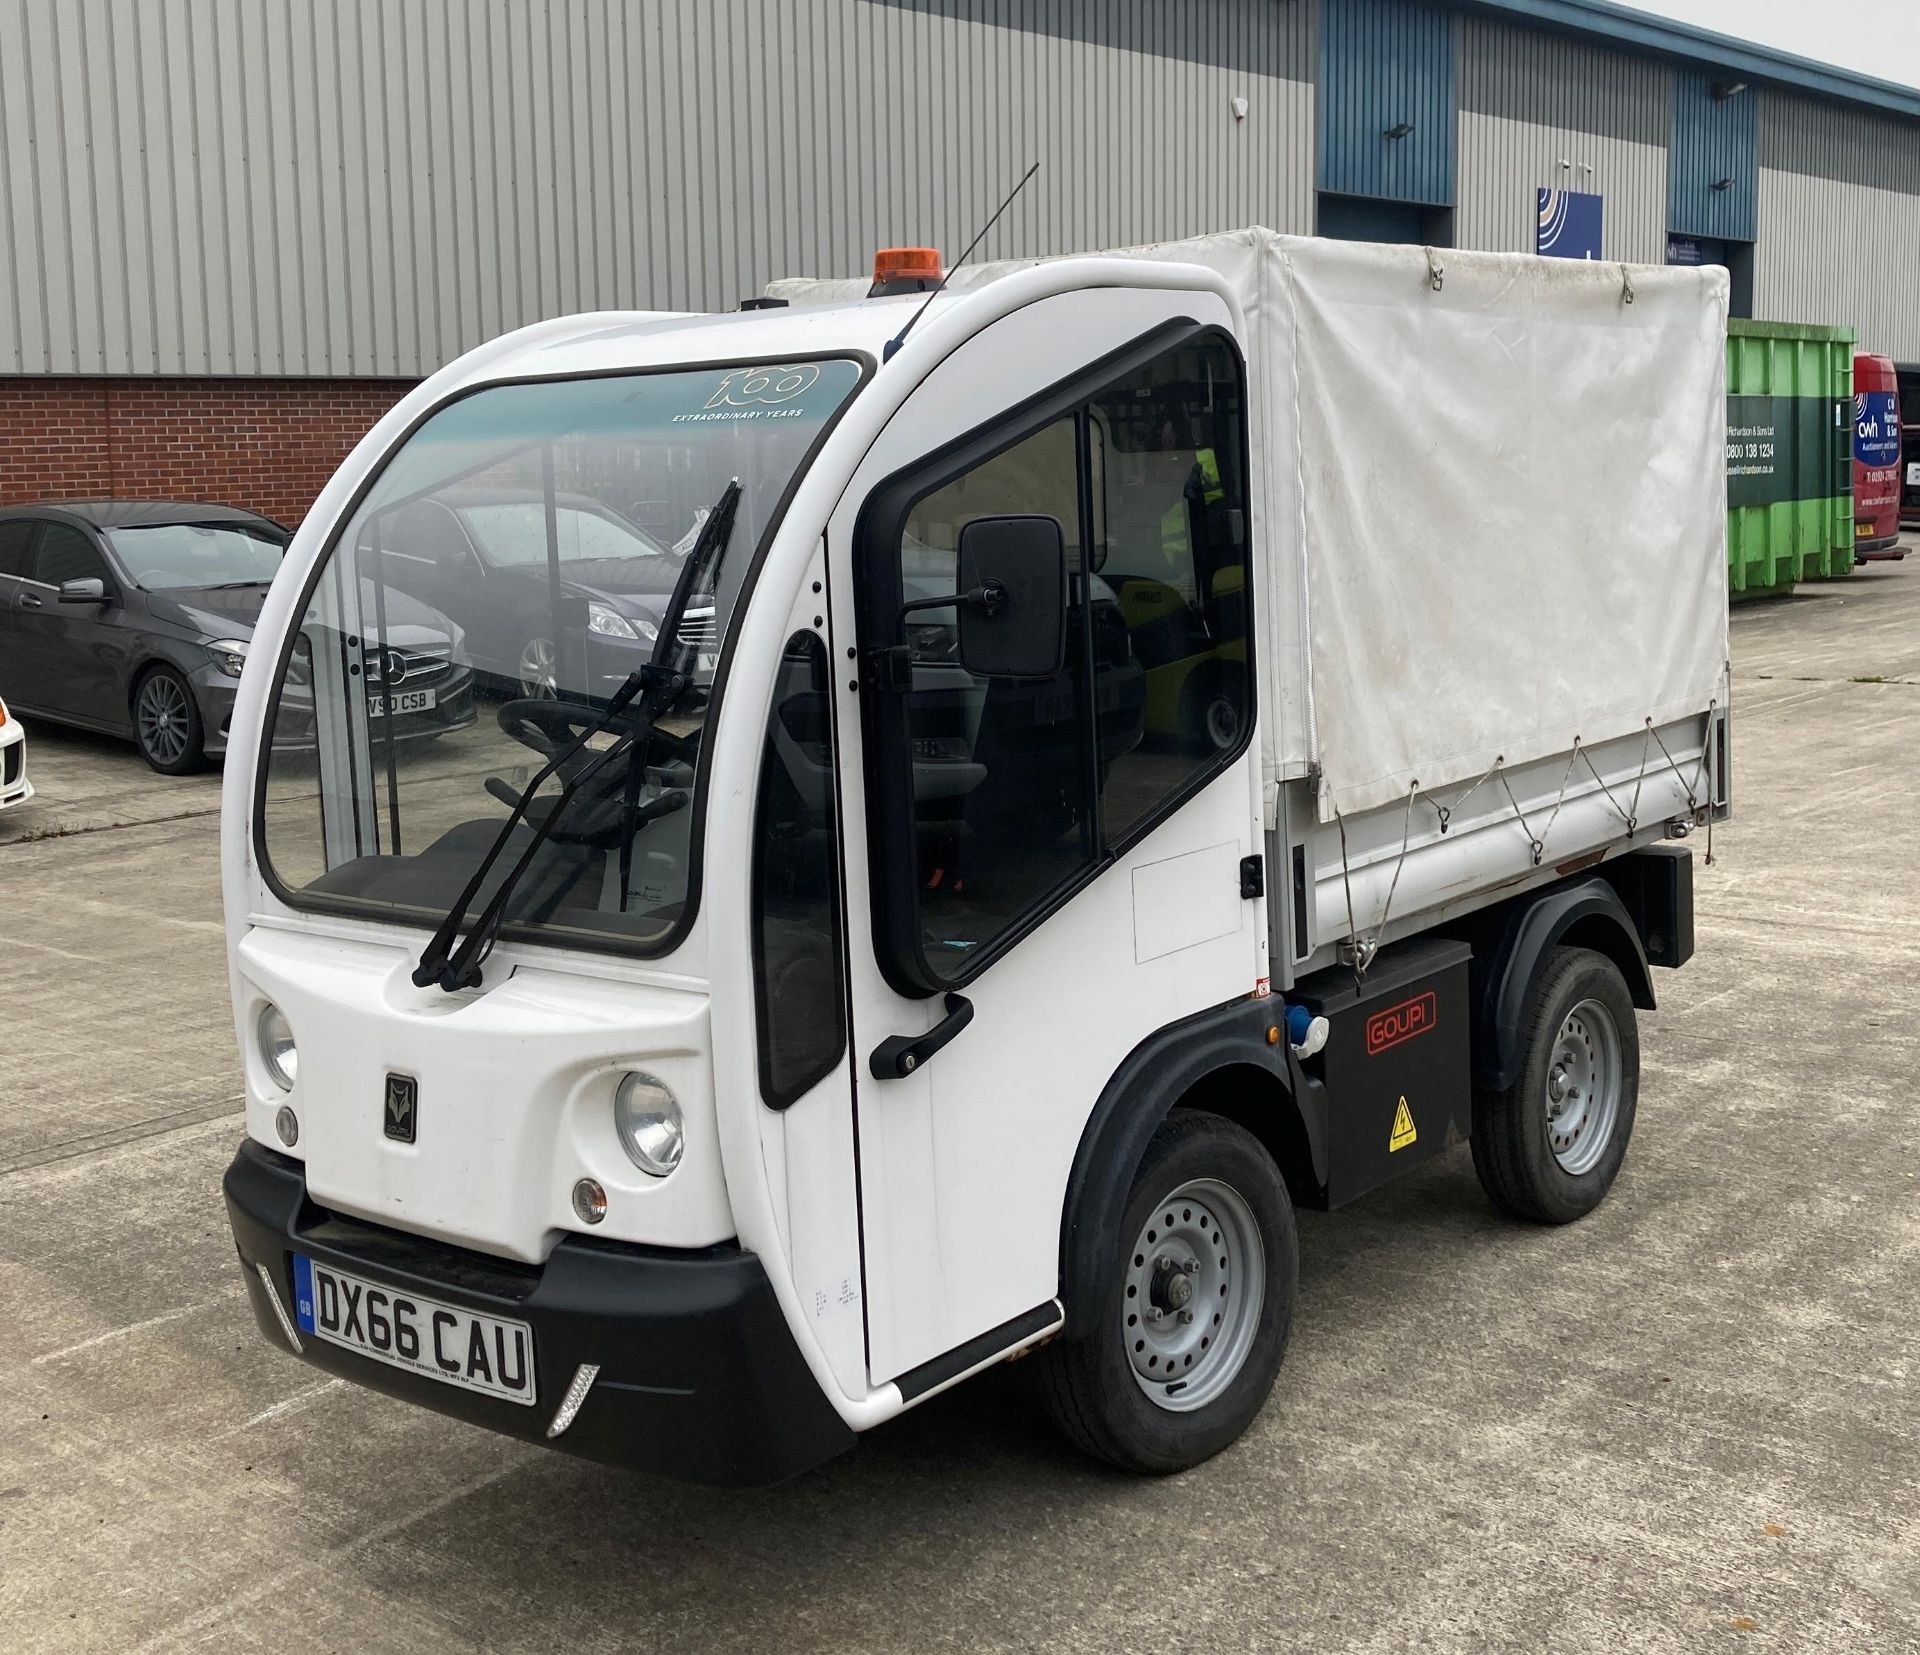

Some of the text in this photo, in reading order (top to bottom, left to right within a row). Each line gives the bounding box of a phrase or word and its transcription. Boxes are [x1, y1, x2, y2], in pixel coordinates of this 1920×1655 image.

[704, 364, 820, 410] 100
[672, 408, 804, 423] EXTRAORDINARY YEARS
[1728, 426, 1752, 437] Richardson
[1753, 425, 1757, 436] &
[1859, 414, 1878, 438] cwh
[1727, 443, 1774, 459] 0800 138 1234
[402, 692, 426, 710] CSB
[300, 1299, 311, 1317] GB
[317, 1270, 526, 1391] DX66 CAU
